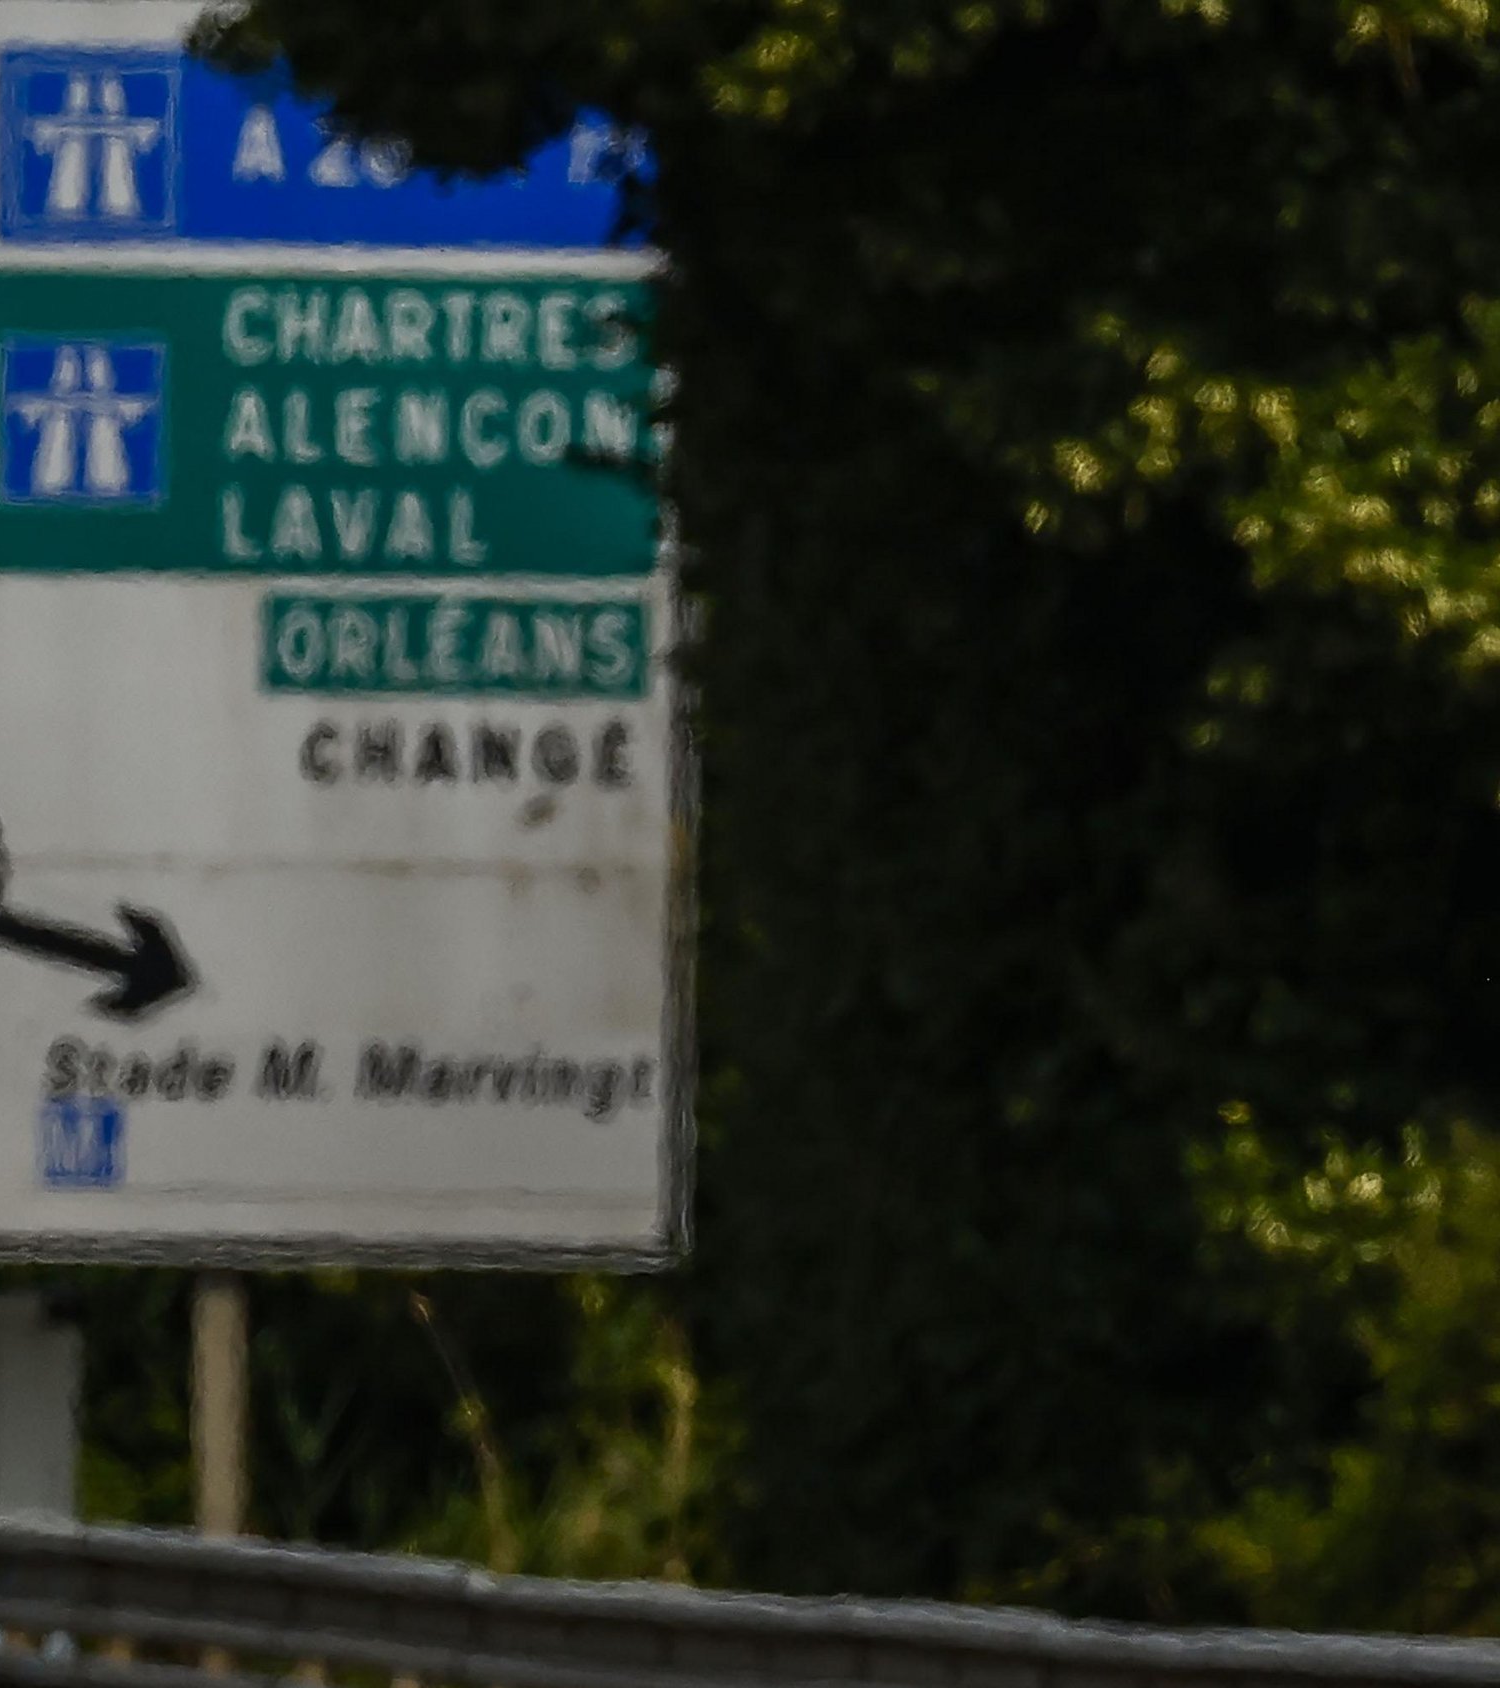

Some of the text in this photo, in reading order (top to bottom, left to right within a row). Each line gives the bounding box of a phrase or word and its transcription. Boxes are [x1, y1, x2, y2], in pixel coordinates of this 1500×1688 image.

[232, 104, 285, 184] A
[222, 284, 638, 370] CHARTRES
[220, 484, 488, 565] LAVAL
[42, 1036, 235, 1102] Stade
